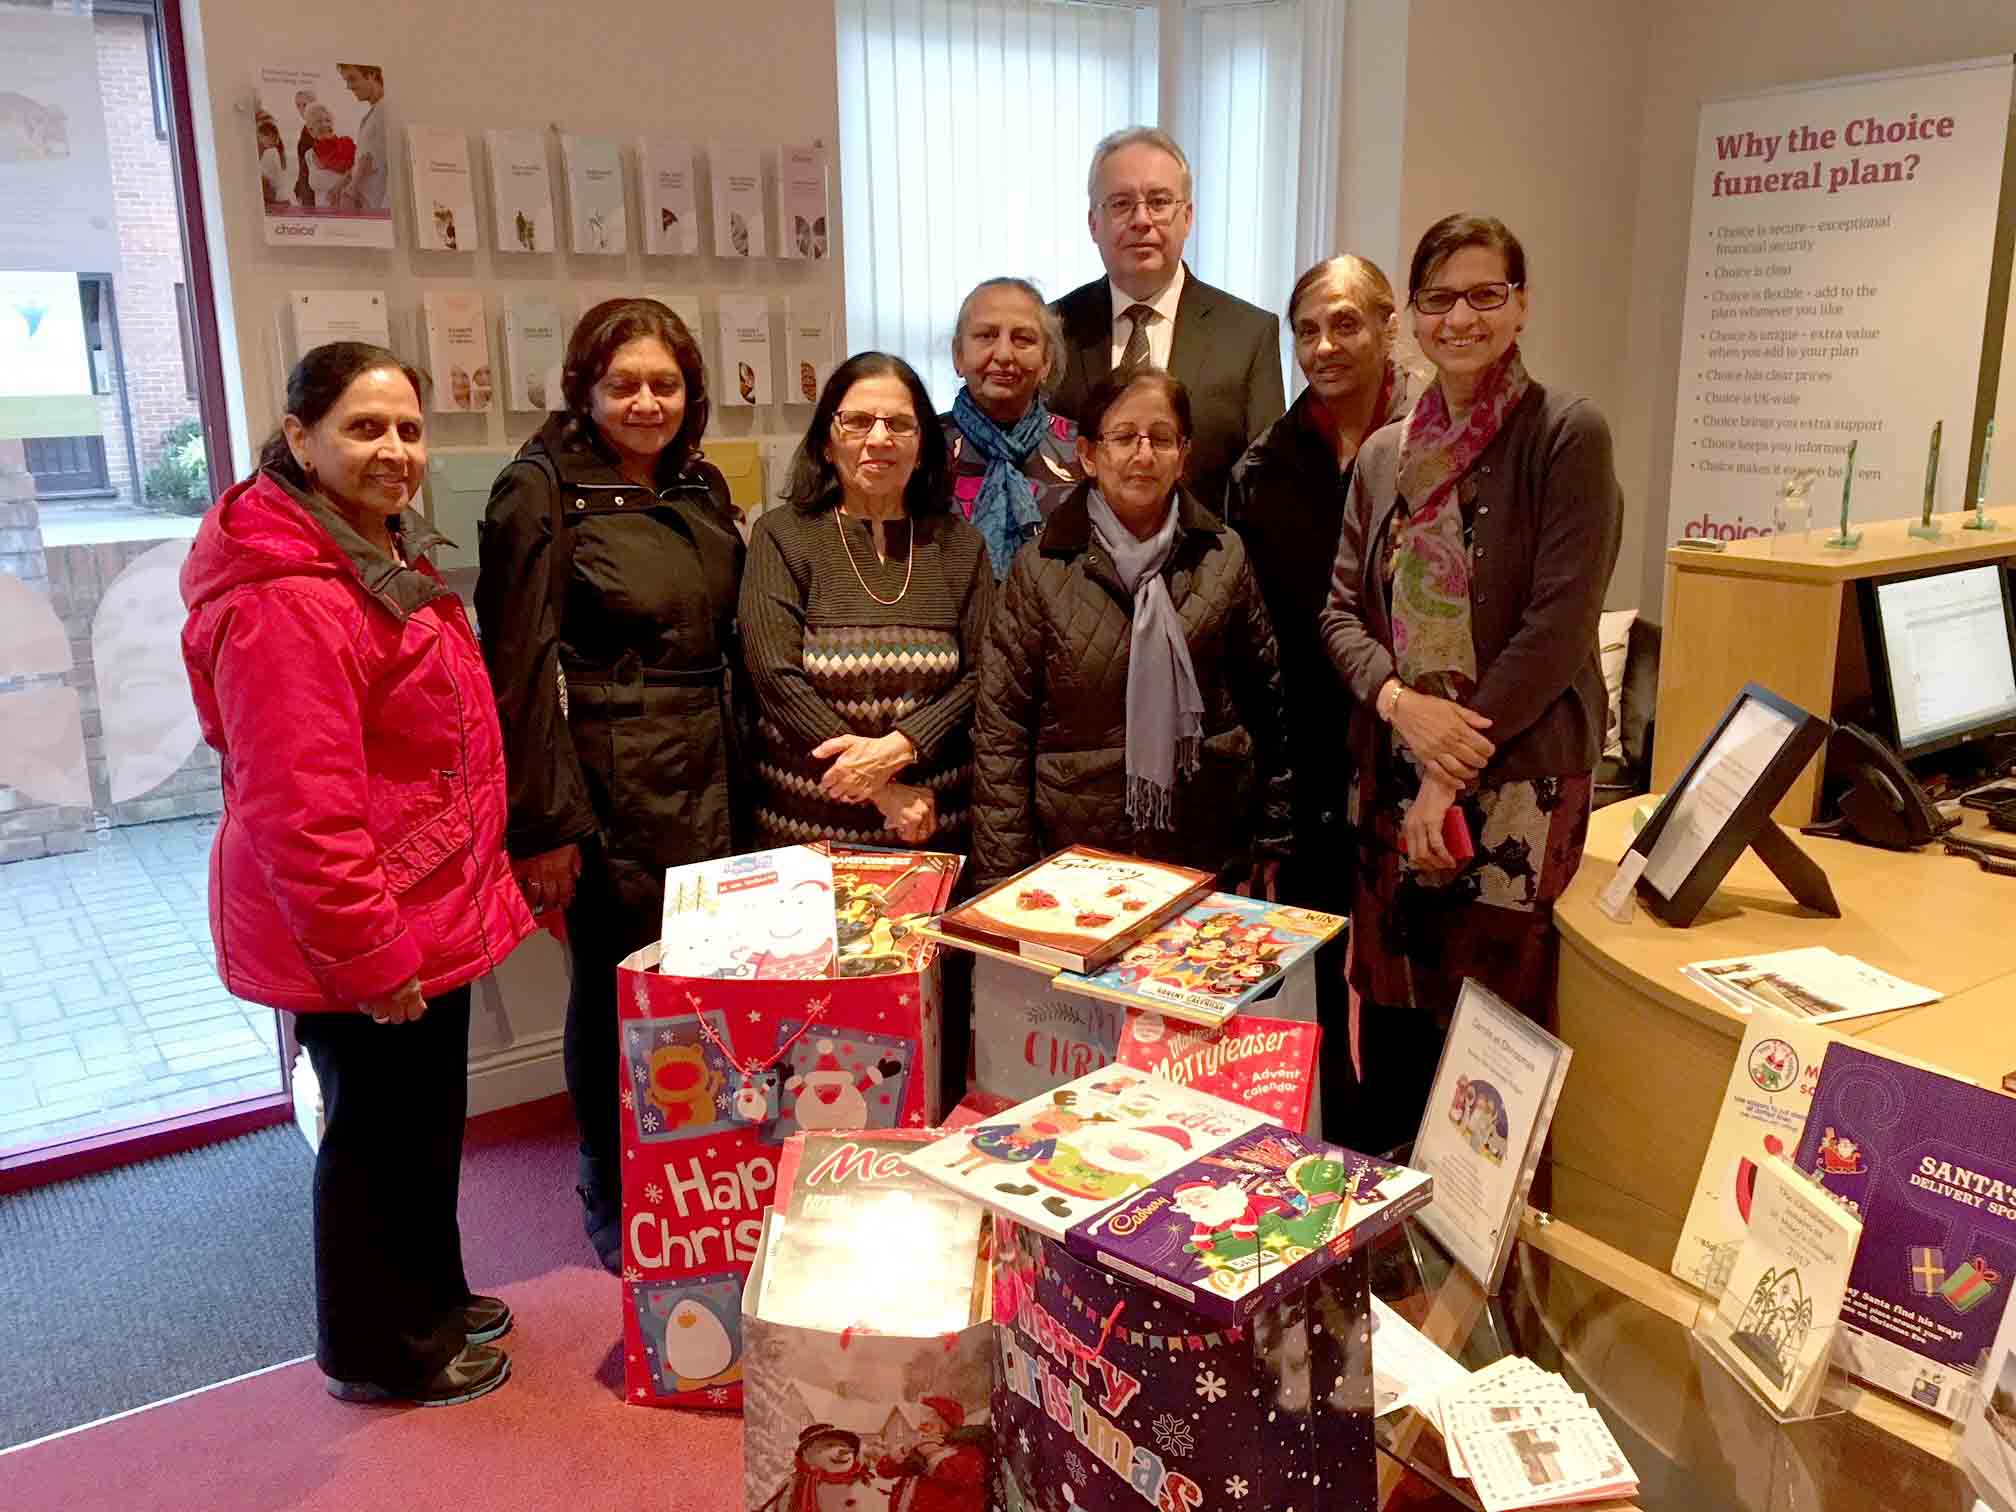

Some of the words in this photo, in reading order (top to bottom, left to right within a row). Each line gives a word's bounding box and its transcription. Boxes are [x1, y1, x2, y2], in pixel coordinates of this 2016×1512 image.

[1715, 130, 1781, 162] Why
[1788, 125, 1836, 152] the
[1845, 113, 1955, 146] Choice
[1712, 161, 1822, 197] funeral
[1827, 153, 1920, 193] plan?
[1717, 225, 1754, 238] Choice
[1714, 265, 1751, 279] Choice
[1712, 290, 1752, 304] Choice
[1763, 286, 1803, 302] flexible
[1814, 285, 1838, 299] add
[1841, 286, 1853, 298] to
[1857, 284, 1878, 298] the
[1711, 305, 1737, 321] plan
[1795, 305, 1817, 317] you
[1820, 303, 1844, 316] like
[1709, 329, 1746, 342] Choice
[1809, 327, 1842, 341] extra
[1846, 327, 1880, 340] value
[1741, 348, 1760, 361] you
[1800, 346, 1828, 360] your
[1830, 344, 1859, 360] plan
[1705, 369, 1742, 381] Choice
[1705, 392, 1740, 404] Choice
[1703, 415, 1738, 427] Choice
[1833, 417, 1883, 432] support
[1701, 438, 1736, 449] Choice
[1252, 1067, 1301, 1083] Advent
[1910, 1173, 1985, 1209] DELIVERY
[1108, 1196, 1170, 1236] Cadbury
[1862, 1291, 1890, 1310] Santa
[1893, 1305, 1915, 1320] find
[1937, 1324, 1963, 1340] way!
[1869, 1314, 1910, 1336] Christmas
